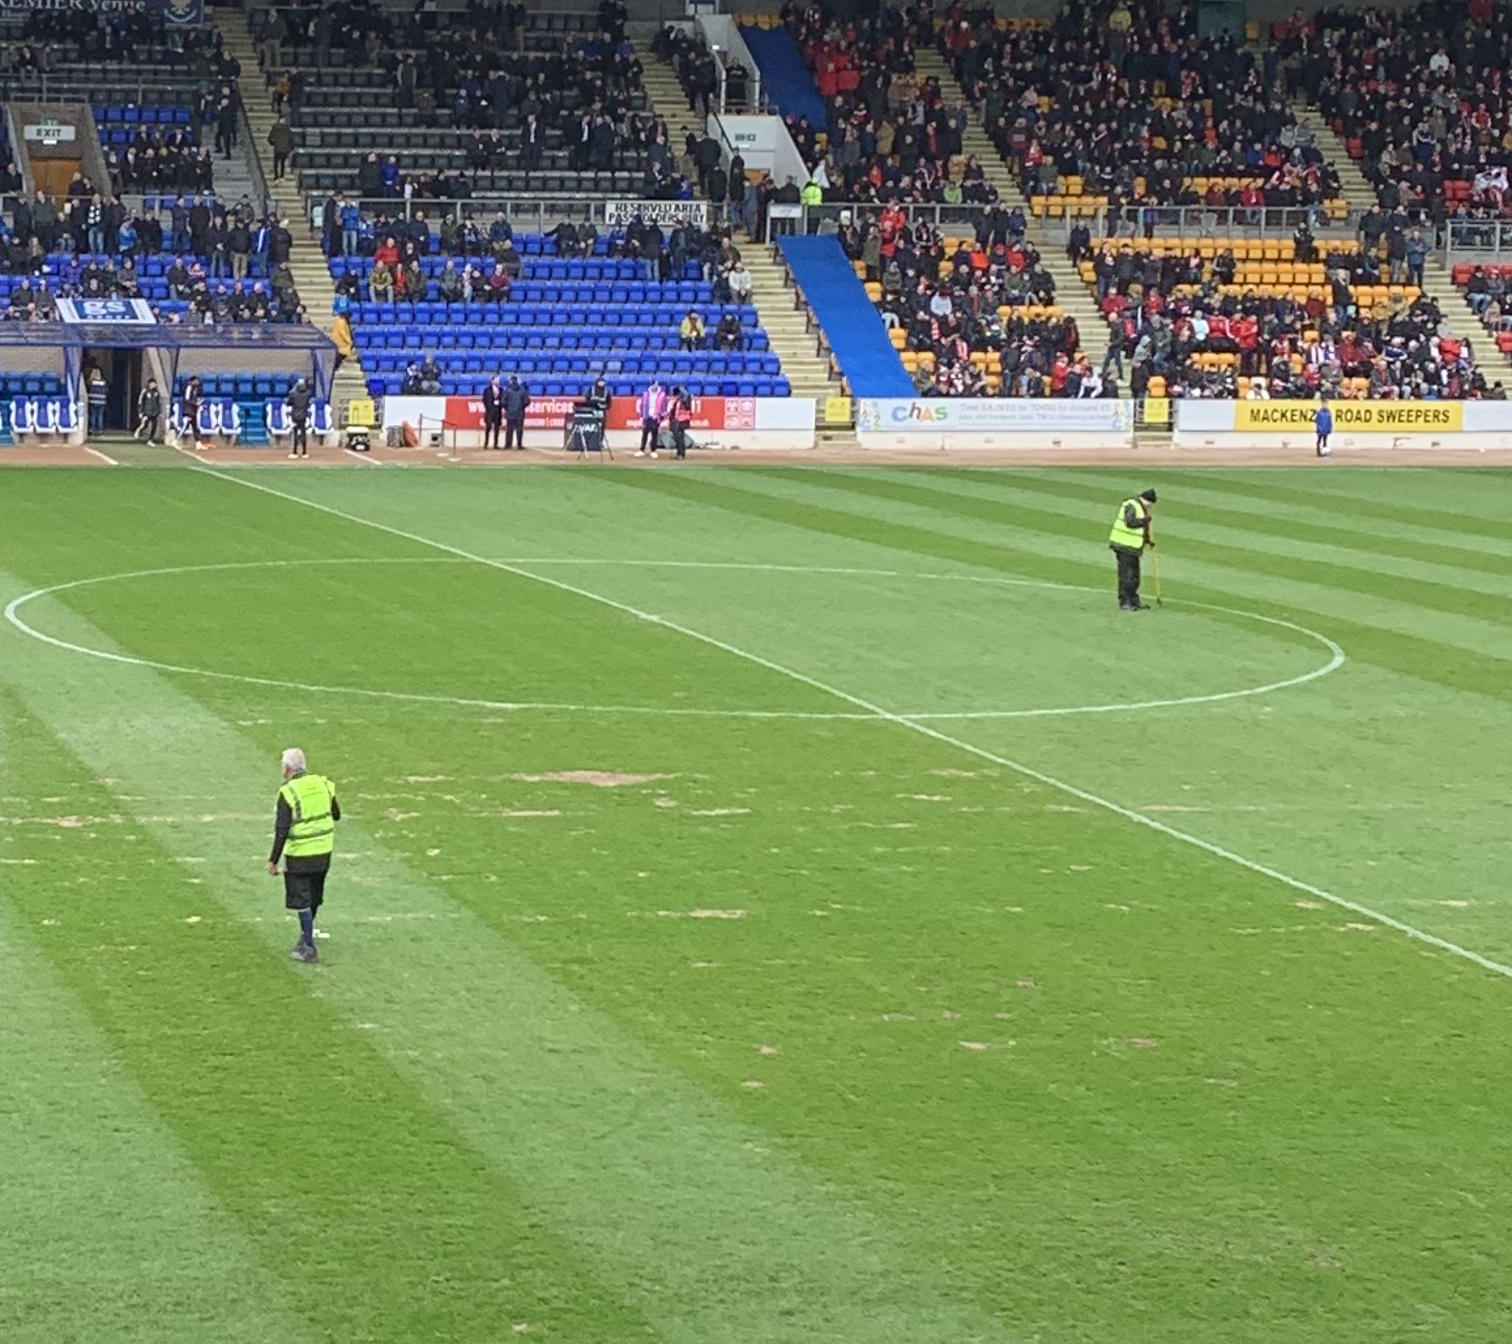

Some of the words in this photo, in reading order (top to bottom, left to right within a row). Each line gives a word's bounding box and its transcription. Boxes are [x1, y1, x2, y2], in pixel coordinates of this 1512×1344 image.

[36, 128, 62, 137] EXIT
[1249, 408, 1317, 424] MACKENZ
[1335, 409, 1373, 424] ROAD
[1377, 409, 1451, 424] SWEEPERS
